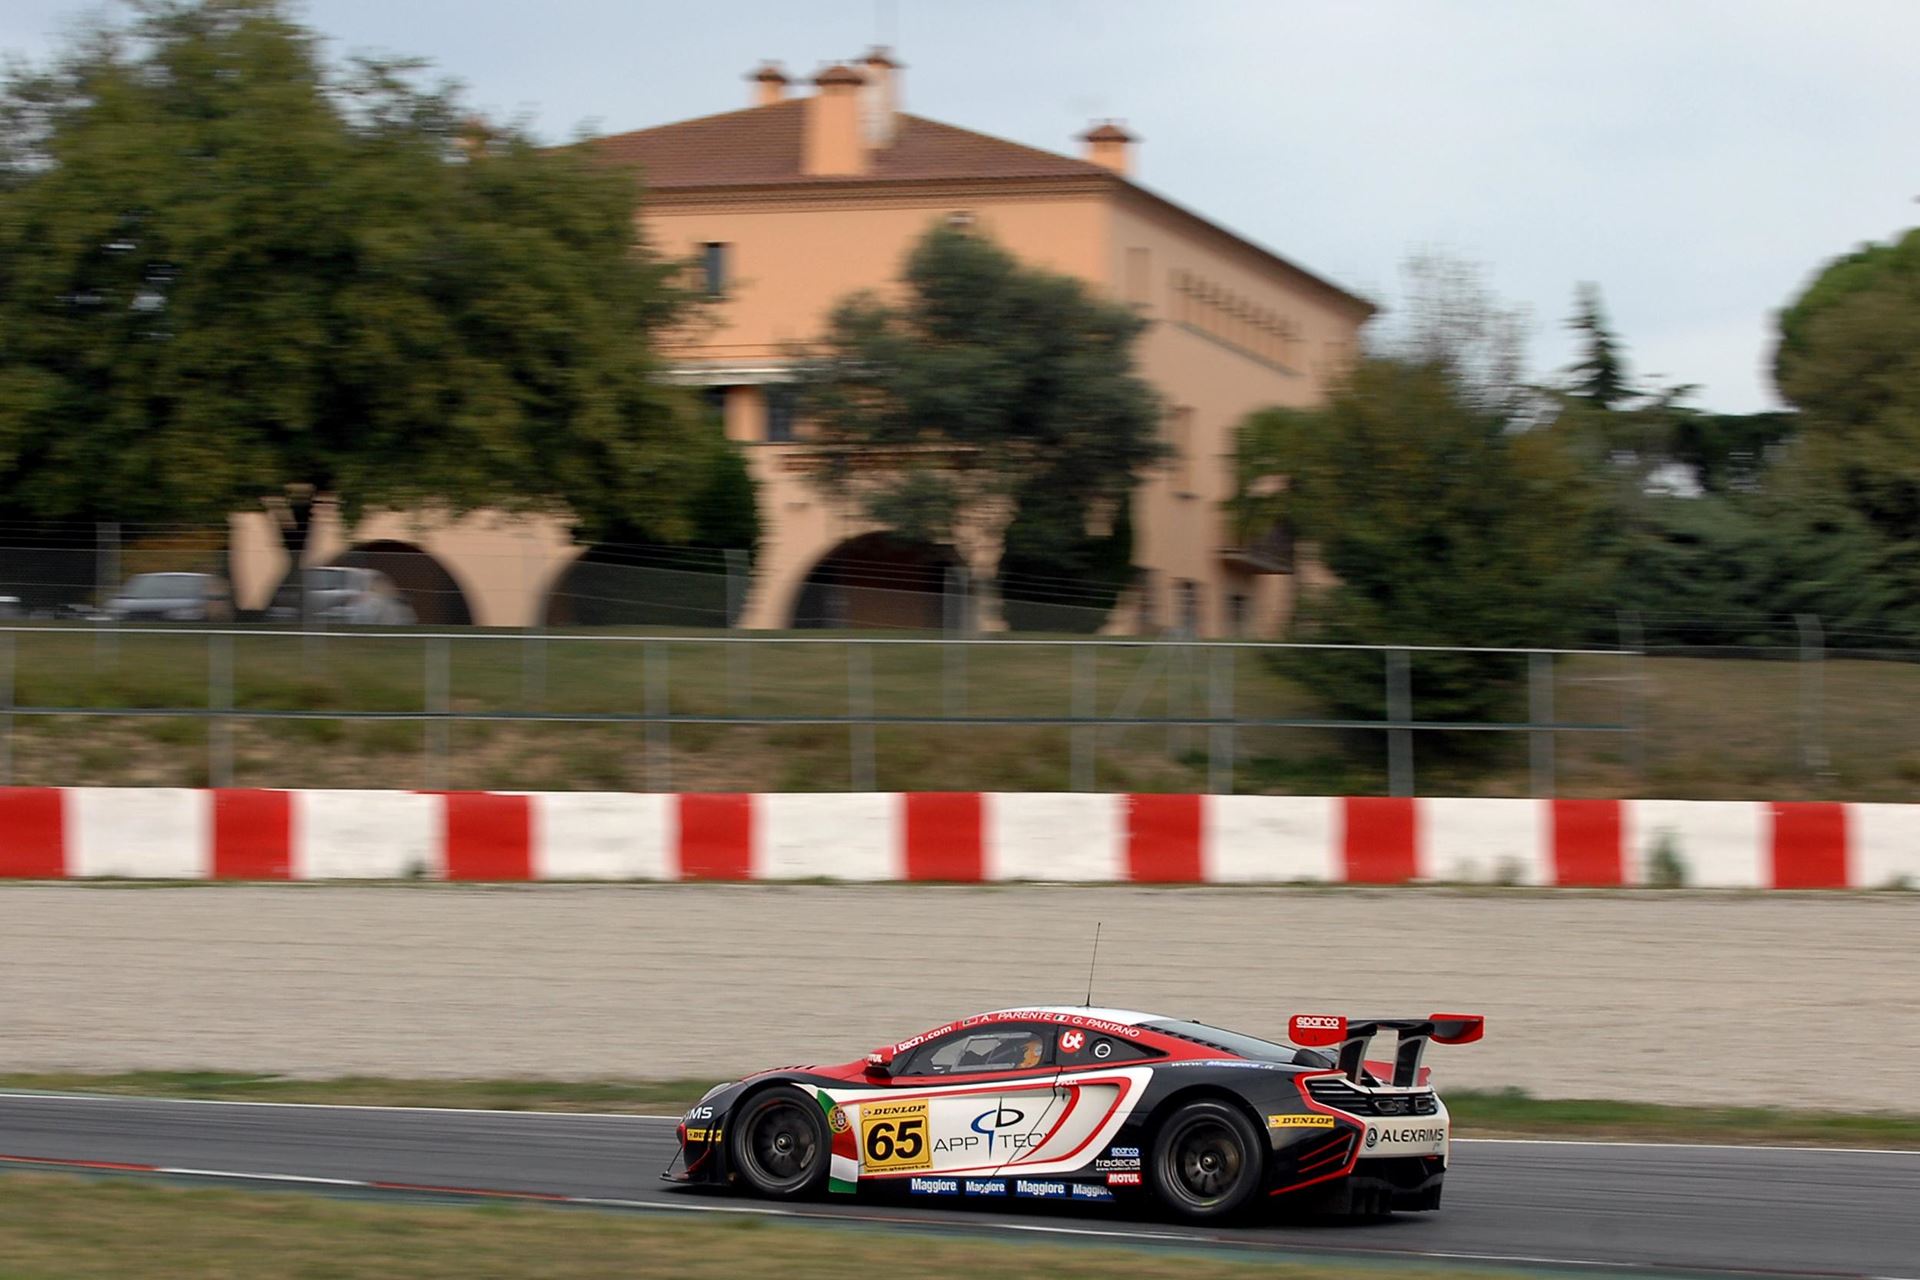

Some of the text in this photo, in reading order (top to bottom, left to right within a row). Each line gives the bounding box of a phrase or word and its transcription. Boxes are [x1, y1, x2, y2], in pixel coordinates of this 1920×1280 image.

[997, 1011, 1052, 1021] PARENTE
[1296, 1016, 1339, 1029] sparco
[1086, 1019, 1140, 1037] PANTANO
[873, 1105, 926, 1115] DUNLOP
[1282, 1117, 1333, 1125] DUNLOP
[866, 1120, 923, 1161] 65
[1380, 1128, 1444, 1142] ALEXRIMS
[934, 1132, 1049, 1152] APP TEC
[1108, 1173, 1140, 1183] MOTUL
[911, 1178, 957, 1193] Maggiore
[966, 1181, 1005, 1193] Maggiore
[1017, 1180, 1065, 1195] Maggiore
